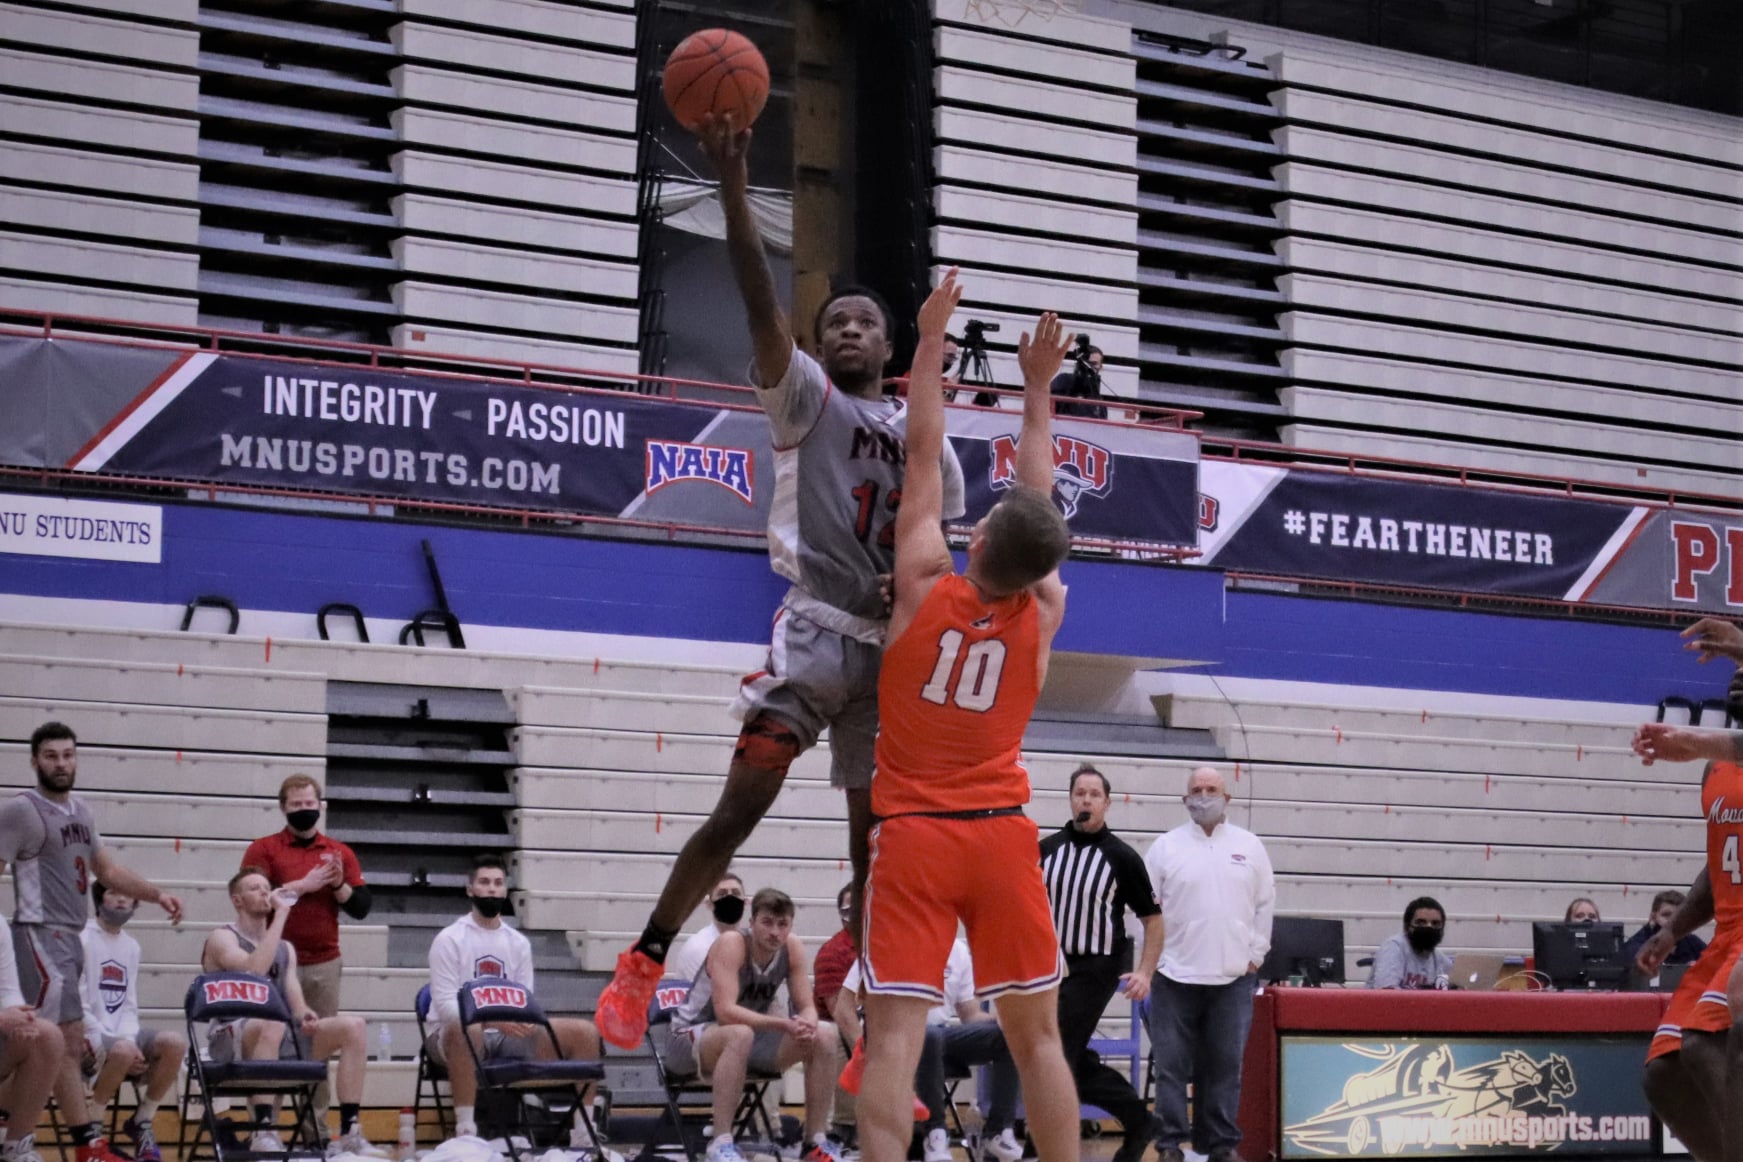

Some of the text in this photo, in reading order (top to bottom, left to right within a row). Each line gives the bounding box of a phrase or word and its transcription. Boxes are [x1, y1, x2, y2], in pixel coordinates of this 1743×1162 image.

[263, 374, 625, 449] INTEGRITY PASSION
[220, 433, 561, 495] MNUSPORTS.COM
[646, 439, 753, 505] NAIA
[36, 514, 151, 545] STUDENTS
[1283, 509, 1554, 566] #FEARTHENEER
[920, 627, 1007, 712] 10
[60, 823, 91, 847] MNU
[1722, 835, 1742, 884] 4
[75, 856, 88, 895] 3
[203, 980, 269, 1004] MNU
[471, 986, 528, 1009] MNU
